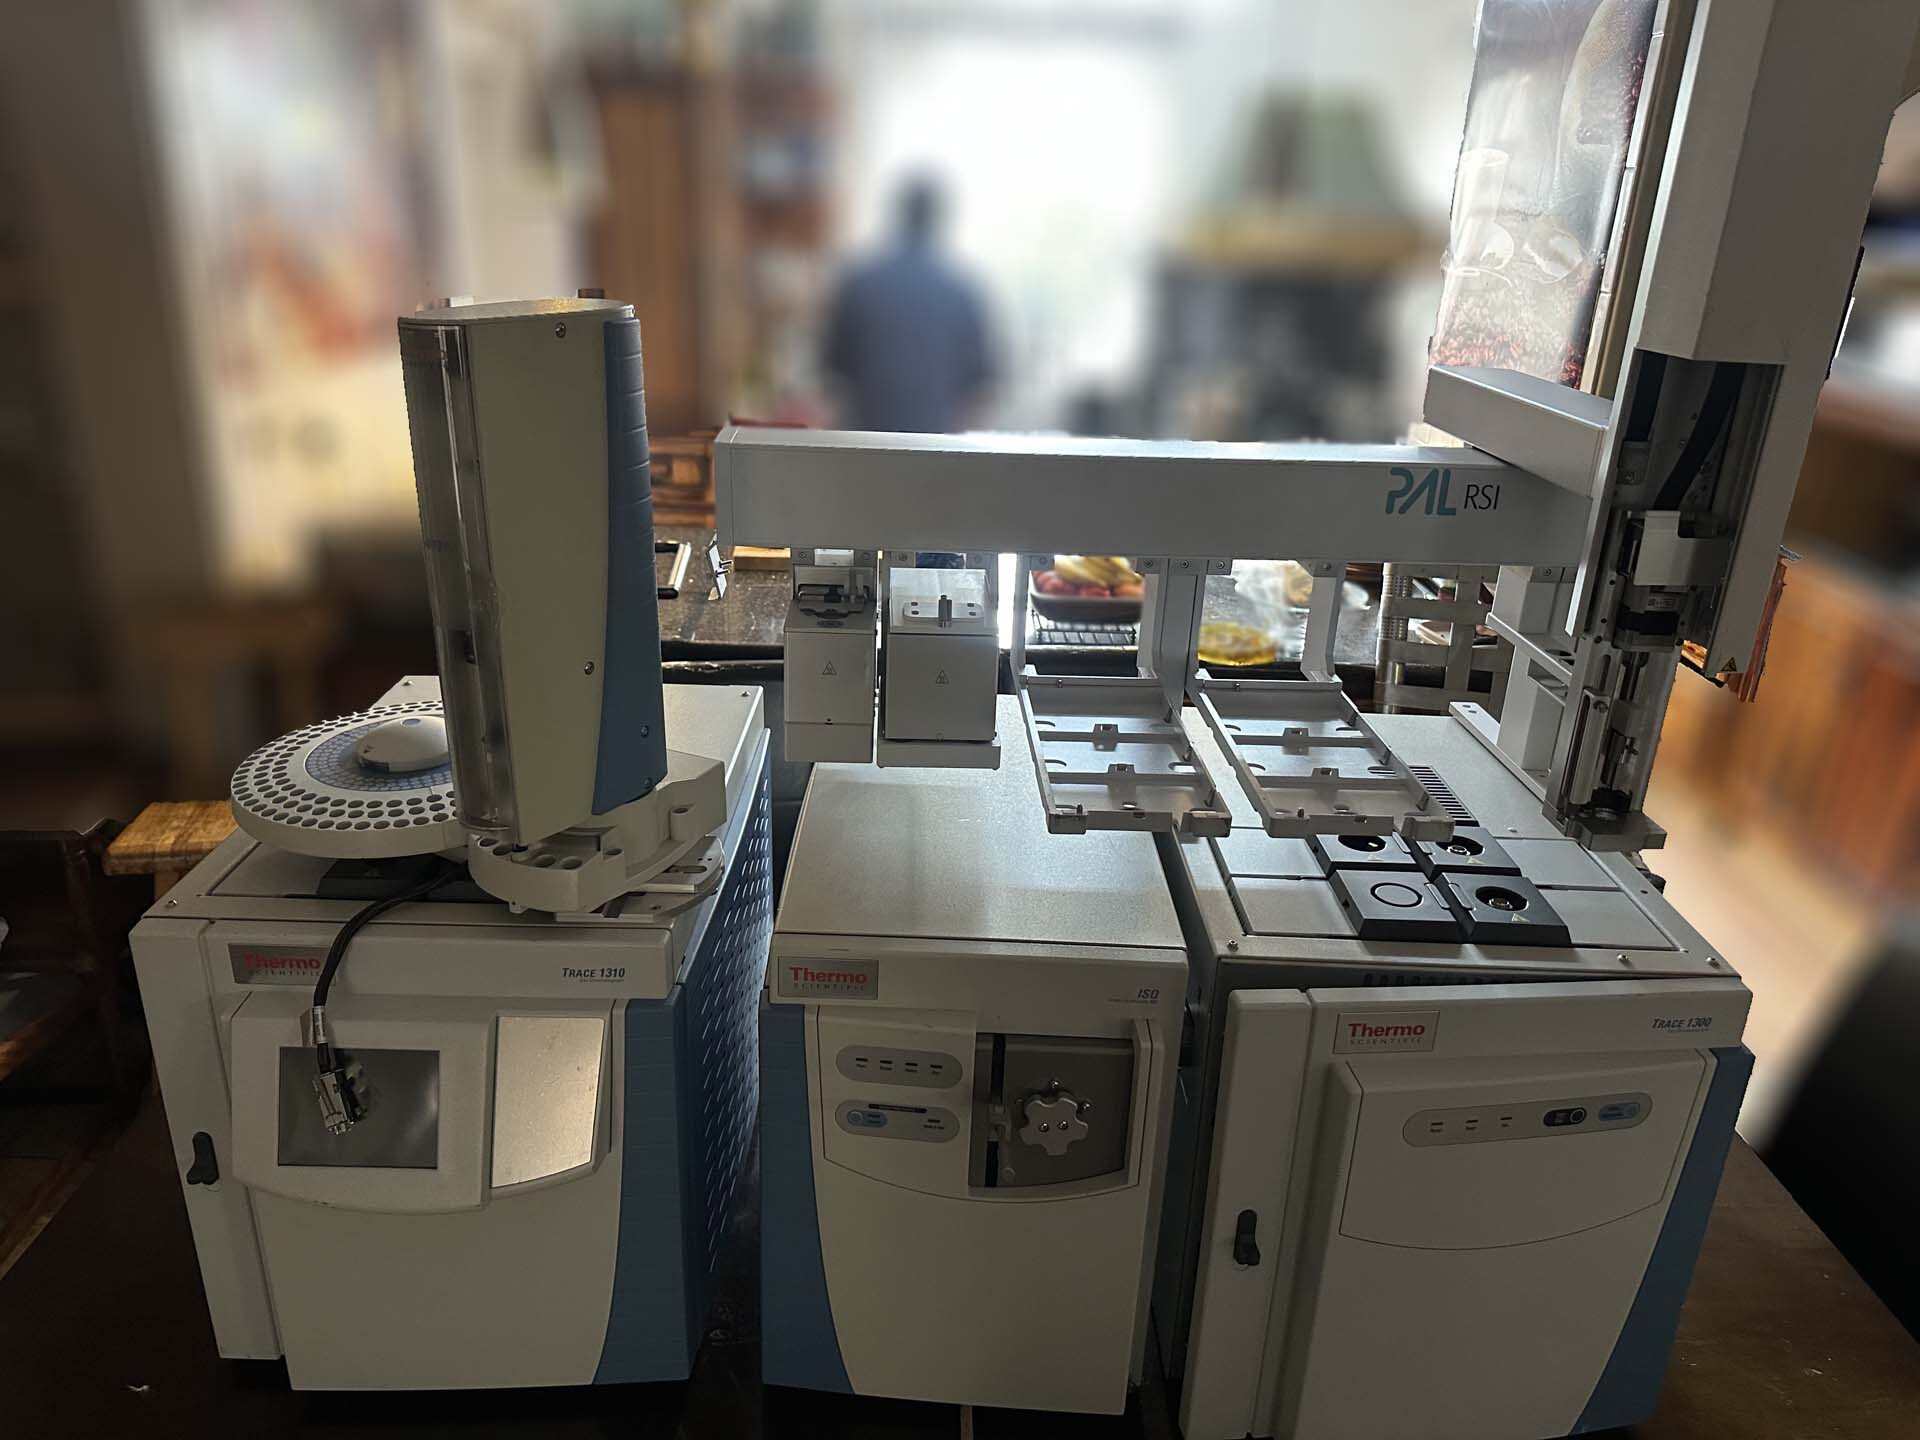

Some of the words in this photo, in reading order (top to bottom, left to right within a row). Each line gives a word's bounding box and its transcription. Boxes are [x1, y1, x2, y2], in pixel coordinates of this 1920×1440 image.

[1385, 466, 1457, 516] PAL
[1463, 483, 1501, 511] RSI
[243, 950, 321, 969] Thermo
[562, 967, 597, 979] TRACE
[600, 967, 625, 979] 1310
[788, 966, 868, 984] Thermo
[1347, 1023, 1426, 1038] Thermo
